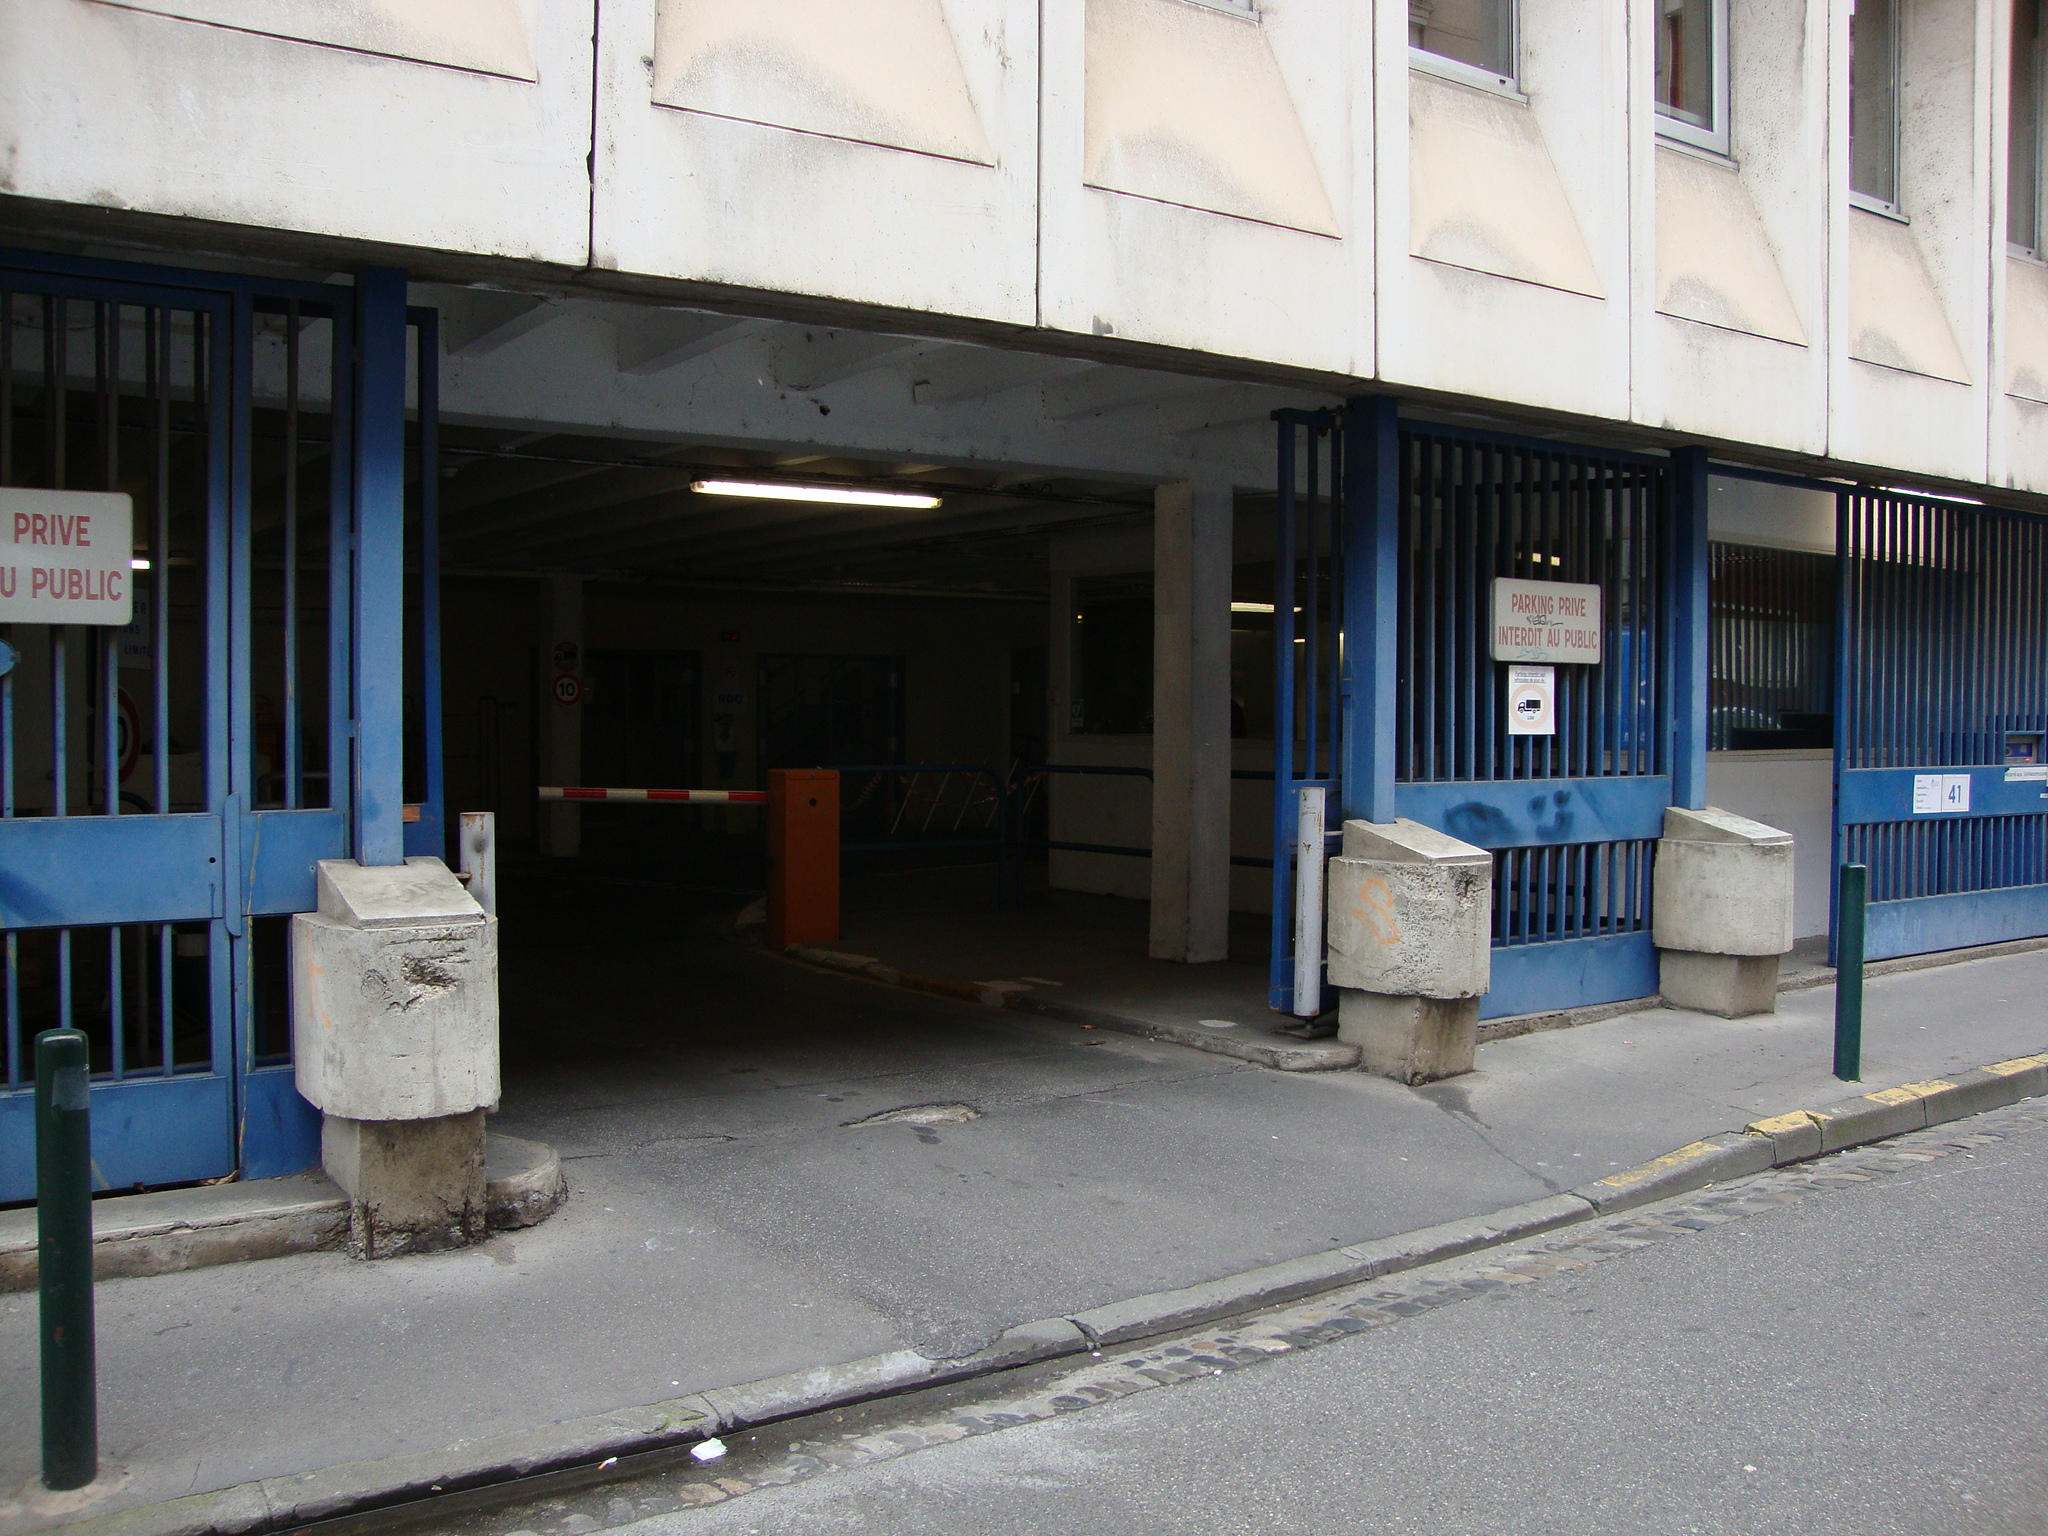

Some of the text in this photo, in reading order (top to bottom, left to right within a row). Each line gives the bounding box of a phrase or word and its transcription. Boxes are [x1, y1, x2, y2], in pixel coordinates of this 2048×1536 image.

[14, 512, 91, 547] PRIVE
[32, 567, 123, 602] PUBLIC
[1511, 593, 1587, 617] PARKING PRIVE
[1498, 625, 1598, 649] INTERDIT AU PUBLIC
[559, 682, 575, 696] 10
[1948, 784, 1961, 804] 41
